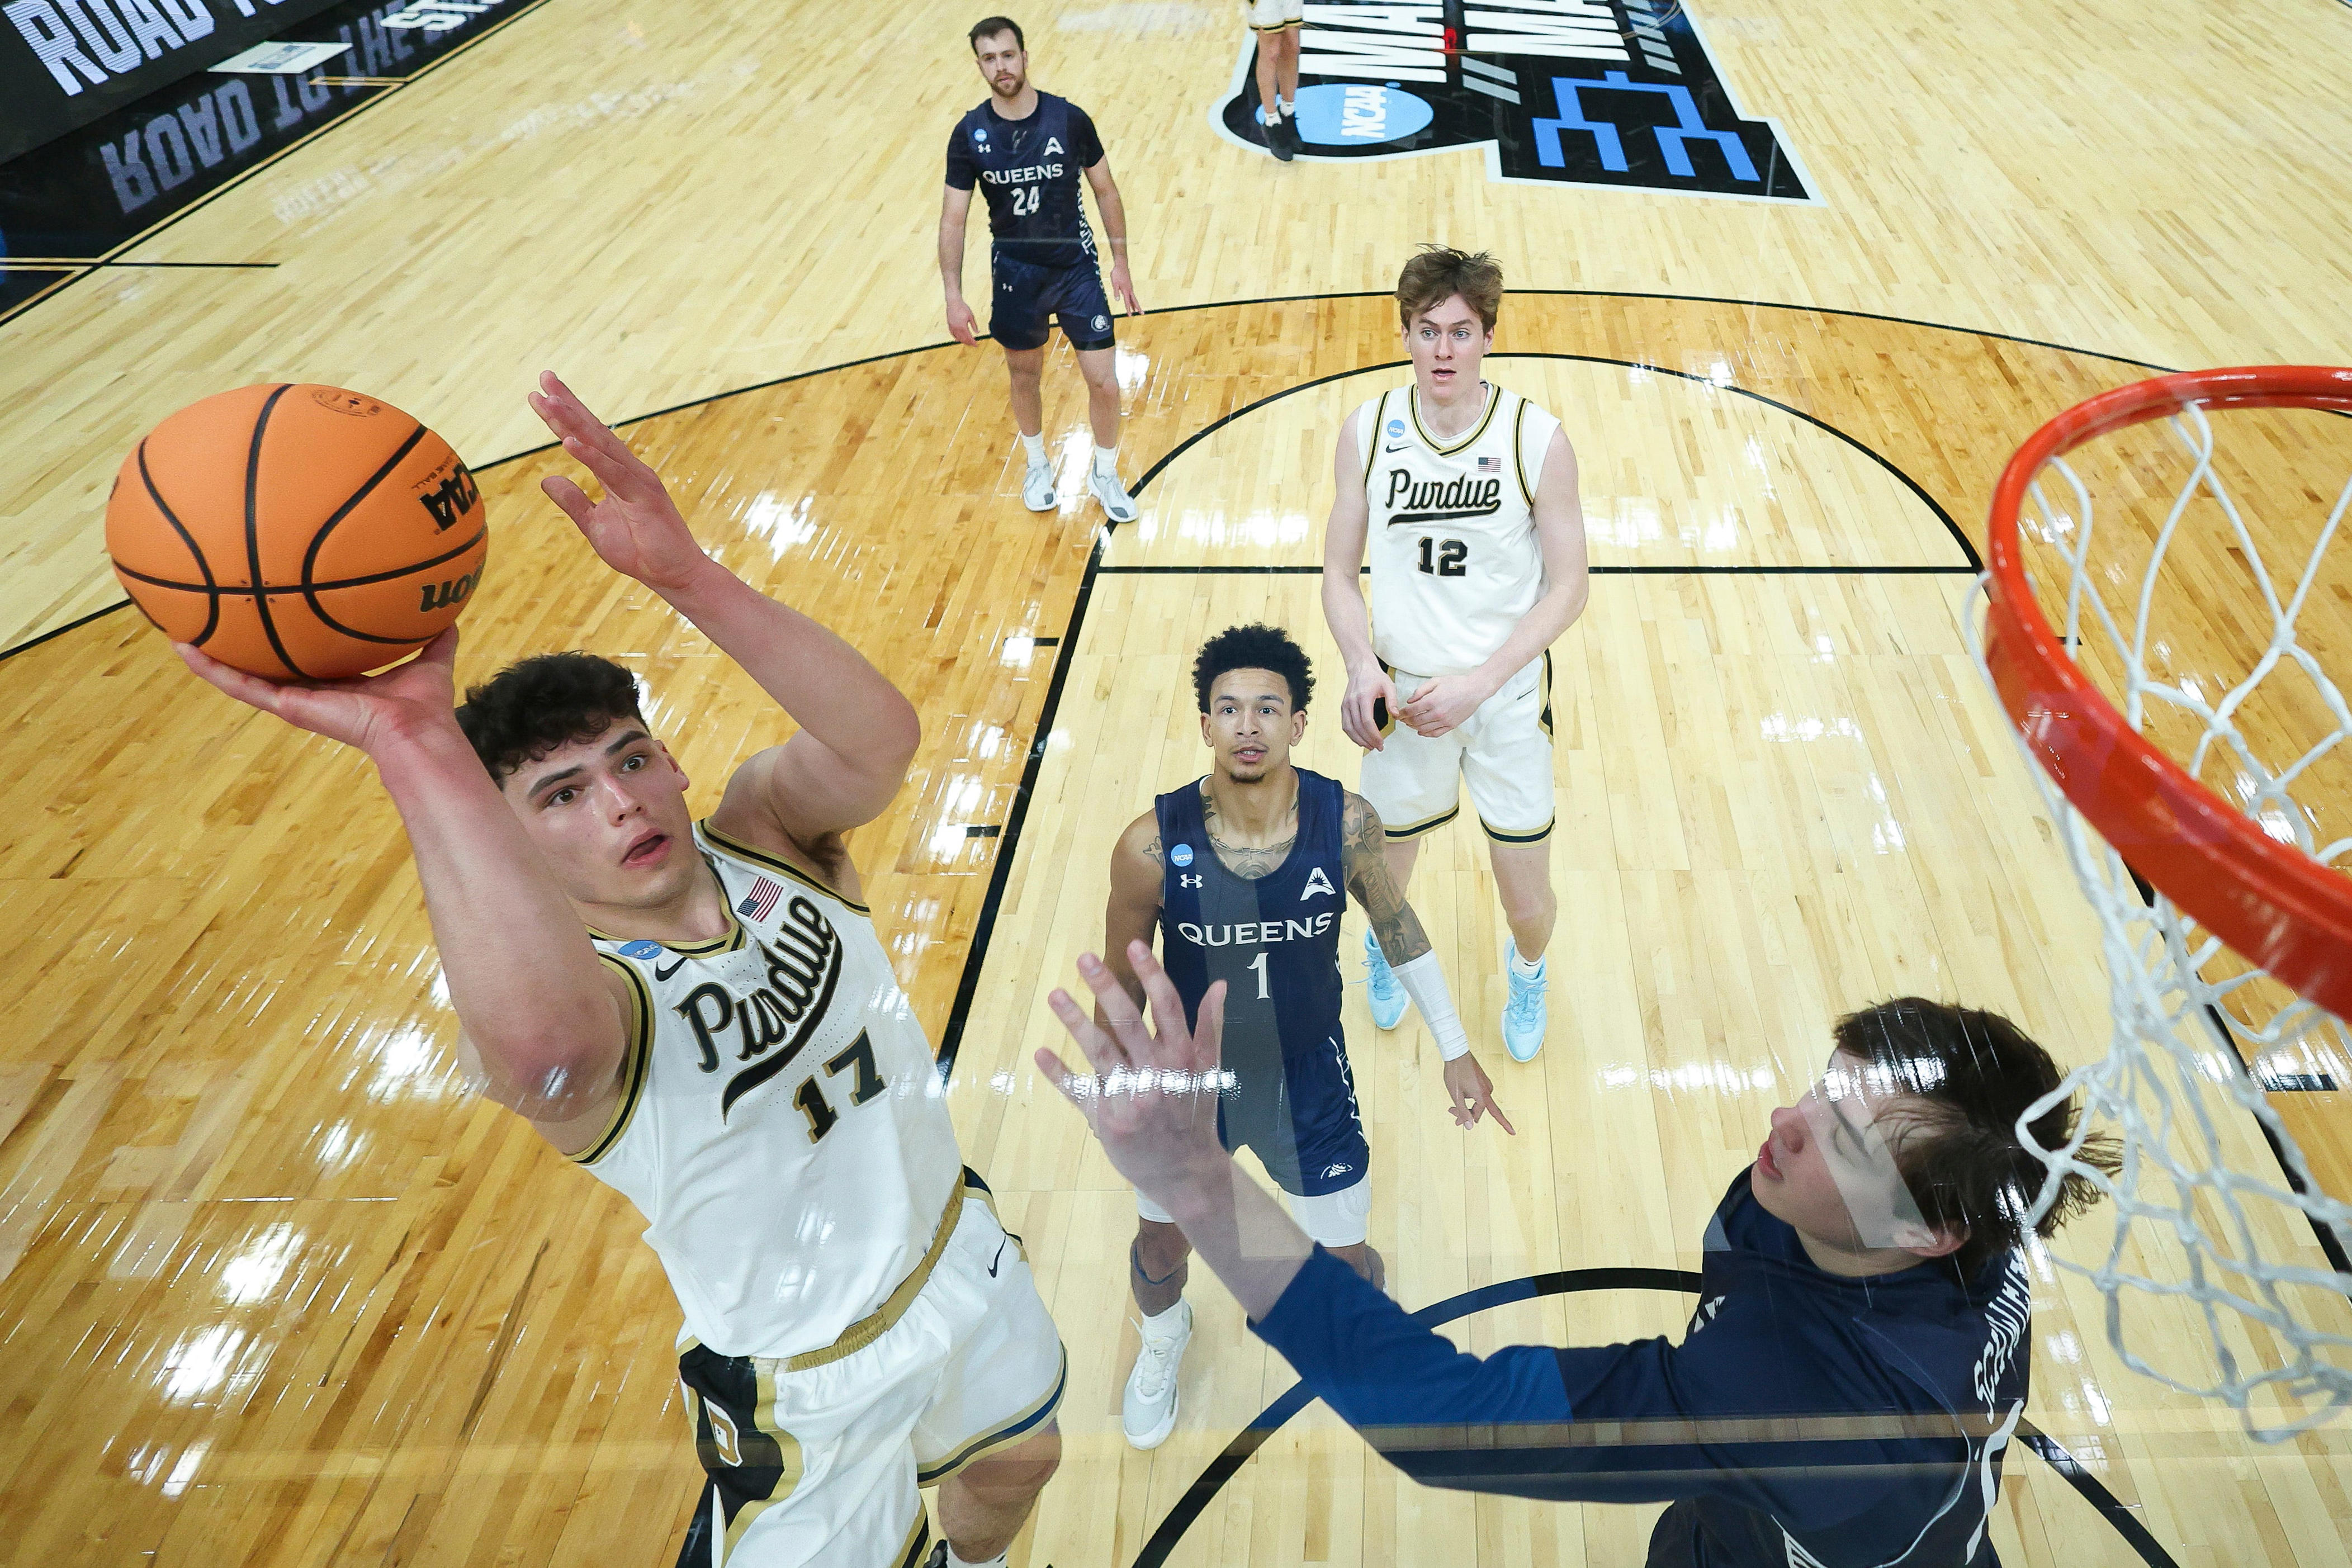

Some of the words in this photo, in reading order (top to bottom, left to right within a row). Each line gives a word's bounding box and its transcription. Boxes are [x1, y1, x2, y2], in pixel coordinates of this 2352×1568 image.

[1298, 0, 1447, 83] MA
[1342, 86, 1388, 139] NCAA
[982, 163, 1063, 185] QUEENS
[1010, 186, 1040, 216] 24
[418, 463, 479, 531] CAA
[1385, 467, 1502, 511] Purdue
[1417, 536, 1468, 577] 12
[1174, 854, 1192, 862] NCAA
[1179, 912, 1334, 946] QUEENS
[672, 896, 837, 1073] Purdue
[1247, 952, 1270, 999] 1
[792, 1026, 887, 1144] 17
